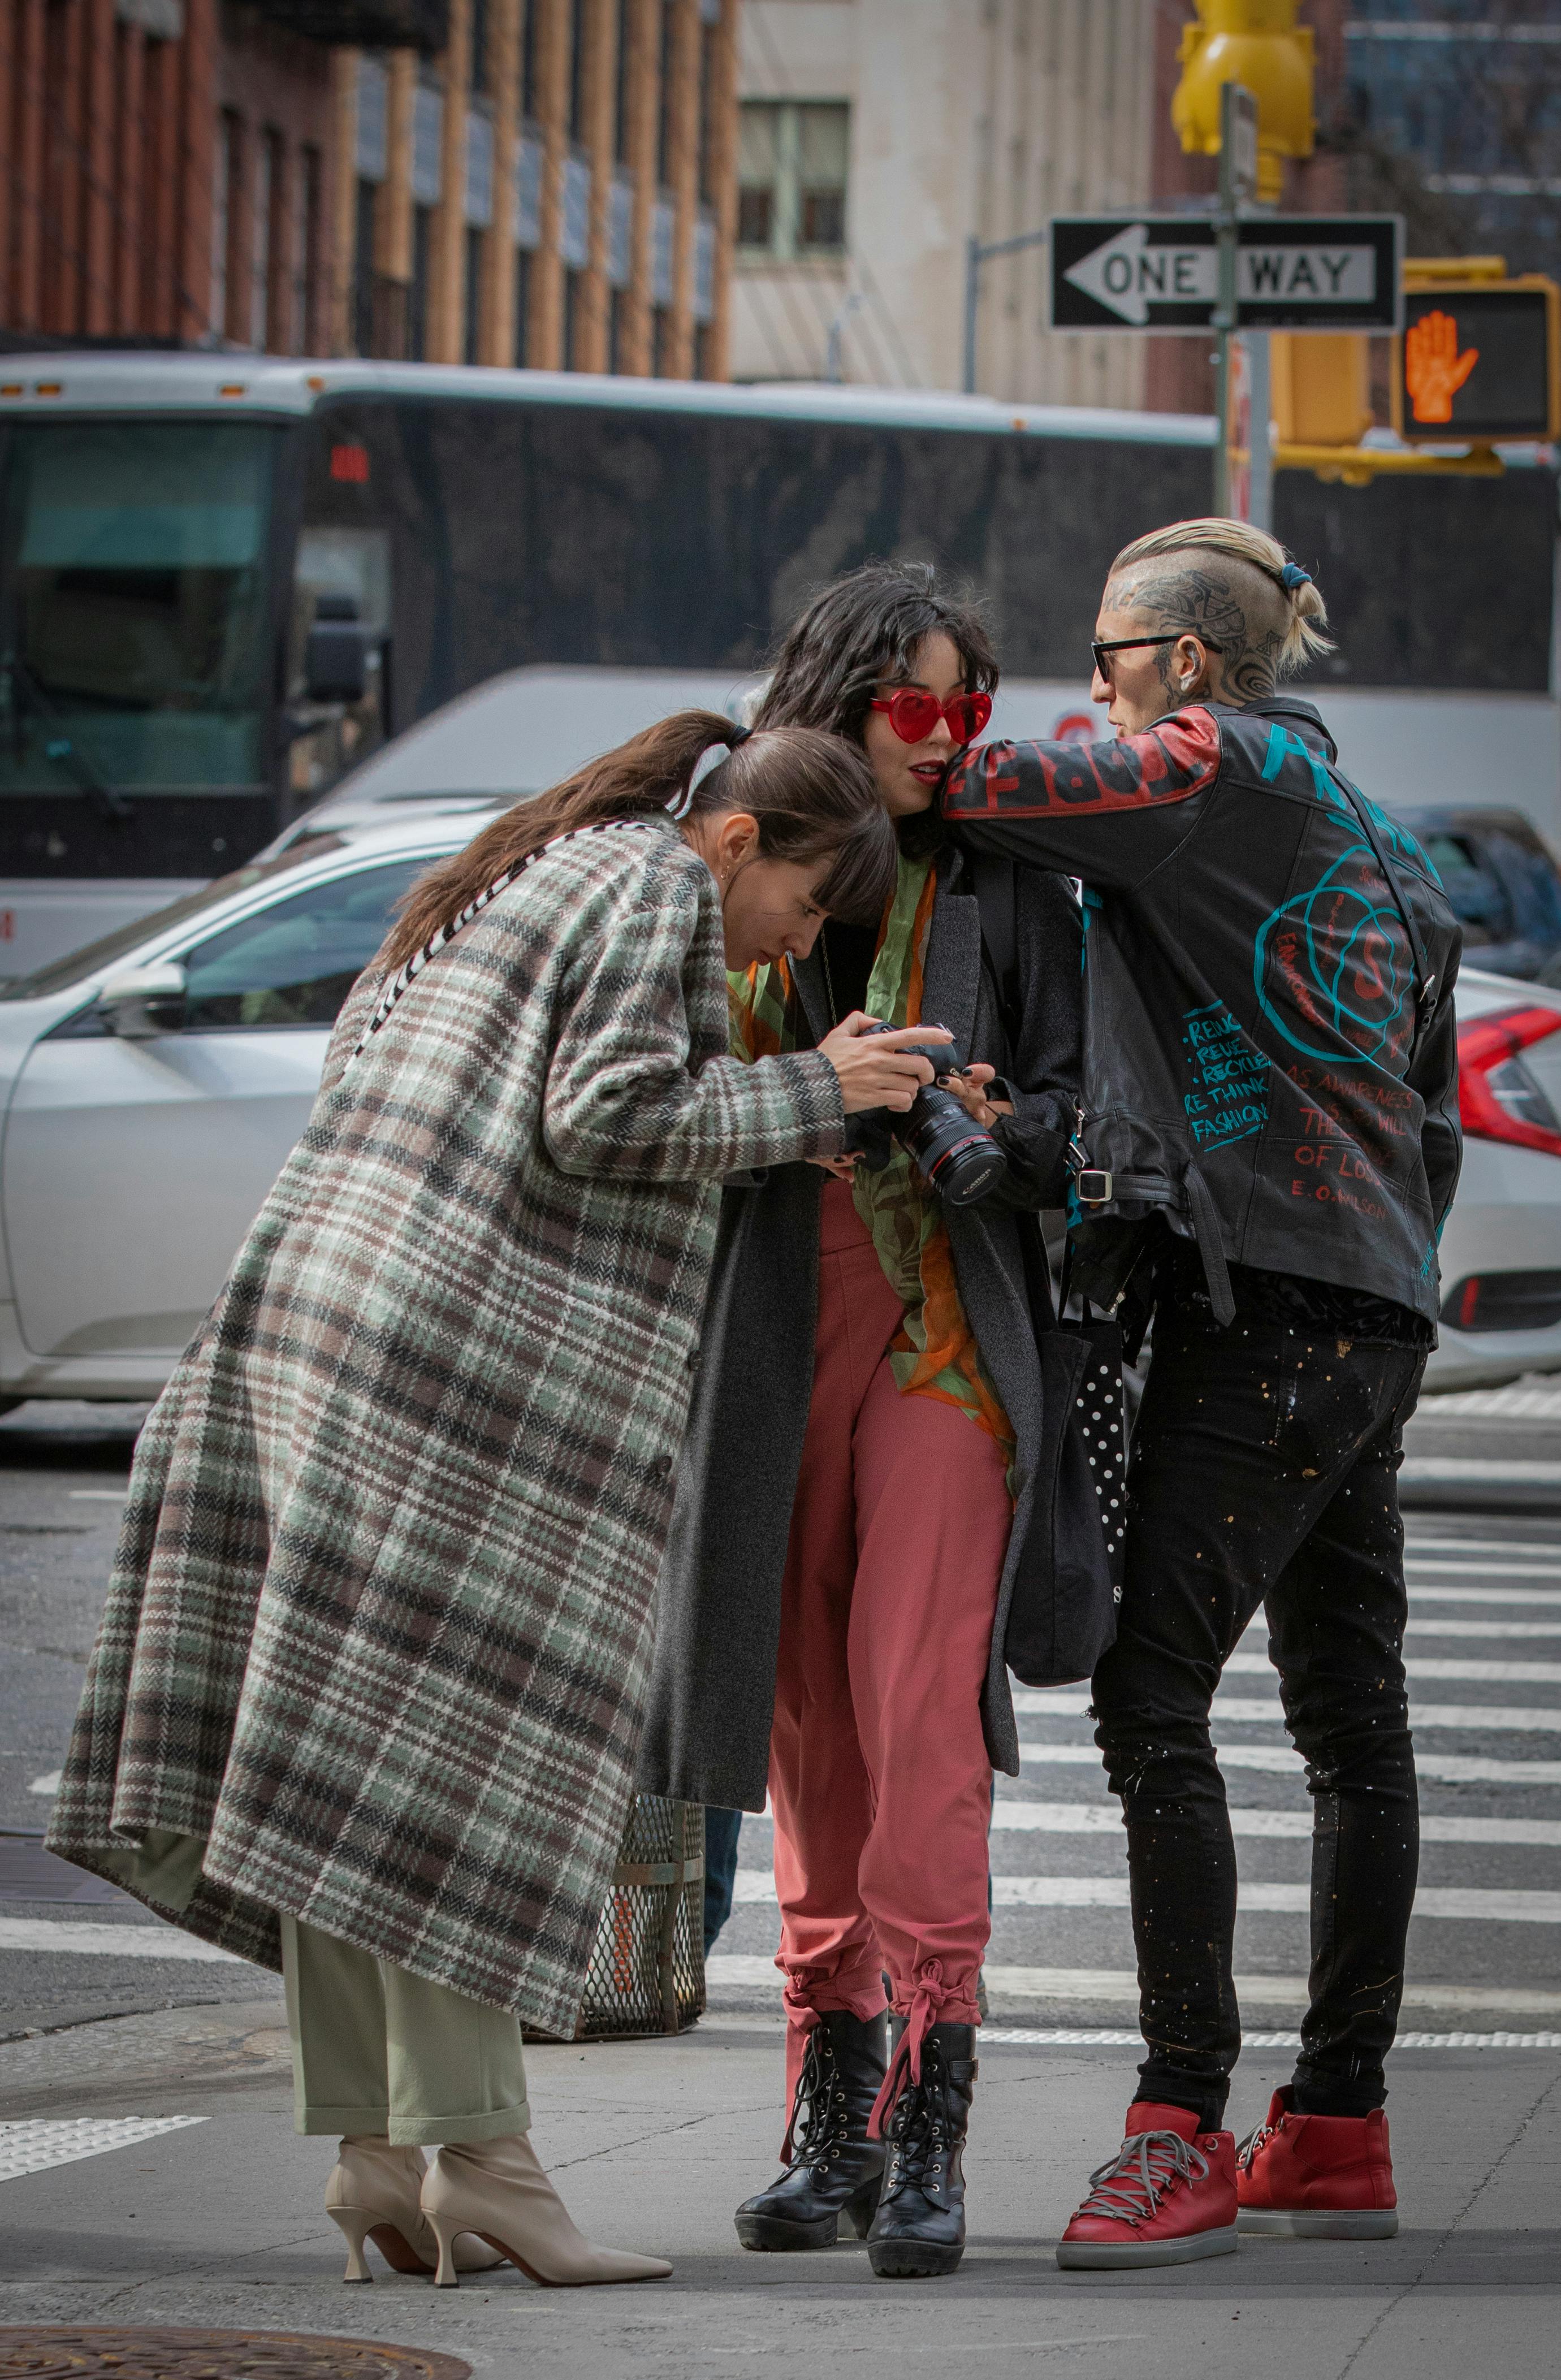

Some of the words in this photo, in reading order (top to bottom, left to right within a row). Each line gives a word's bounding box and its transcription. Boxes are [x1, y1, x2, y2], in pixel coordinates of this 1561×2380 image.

[1103, 253, 1199, 295] ONE
[1248, 253, 1351, 294] WAY
[1286, 1064, 1312, 1089] AS
[1207, 1077, 1269, 1104] THINK
[1191, 1103, 1269, 1143] FASHION
[1377, 1110, 1408, 1136] WILL
[1294, 1145, 1333, 1167] OF
[962, 1169, 991, 1195] Canon
